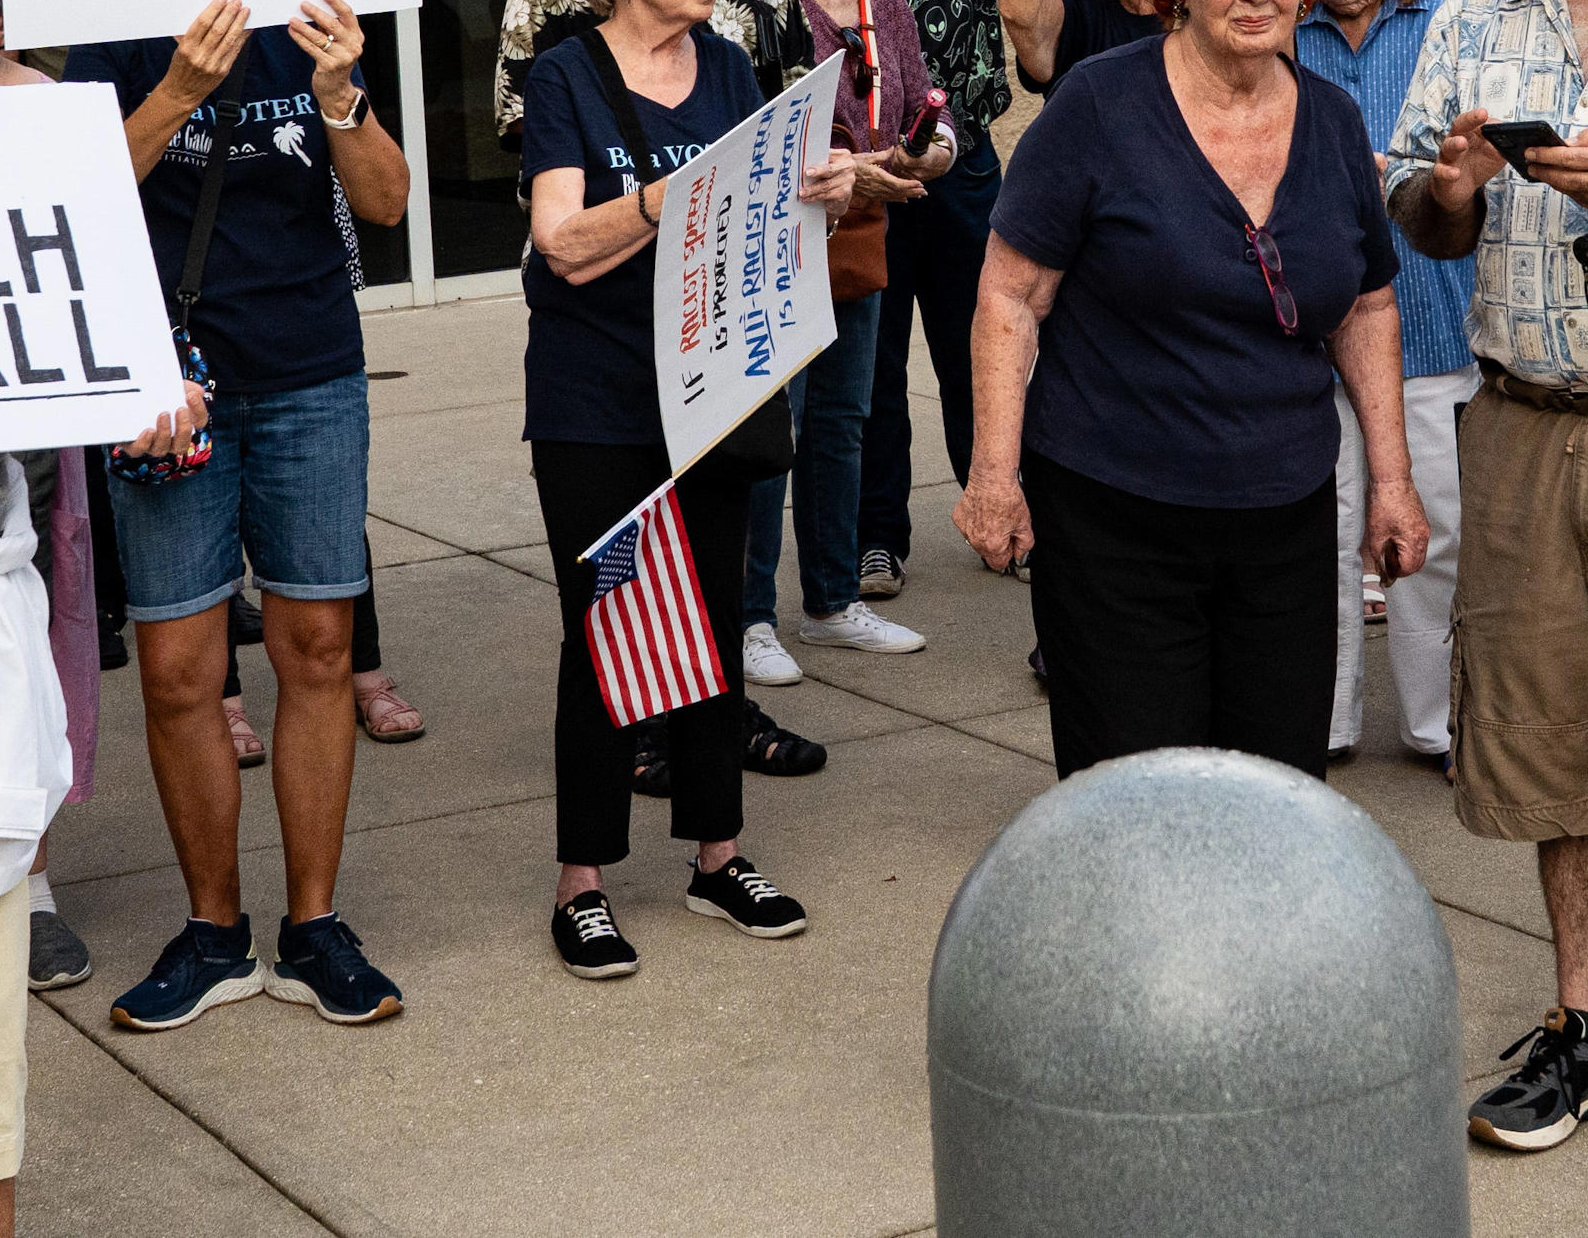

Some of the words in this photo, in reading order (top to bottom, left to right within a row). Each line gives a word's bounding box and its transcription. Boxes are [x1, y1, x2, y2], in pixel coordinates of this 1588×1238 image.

[748, 104, 778, 203] SPEECH
[683, 174, 707, 262] SPEECH
[712, 194, 732, 325] PROTECTED
[776, 227, 794, 292] ALSO
[680, 262, 702, 355] RACIST
[738, 202, 772, 379] ANTI-RACIST
[780, 299, 796, 330] IS
[682, 368, 706, 407] IF
